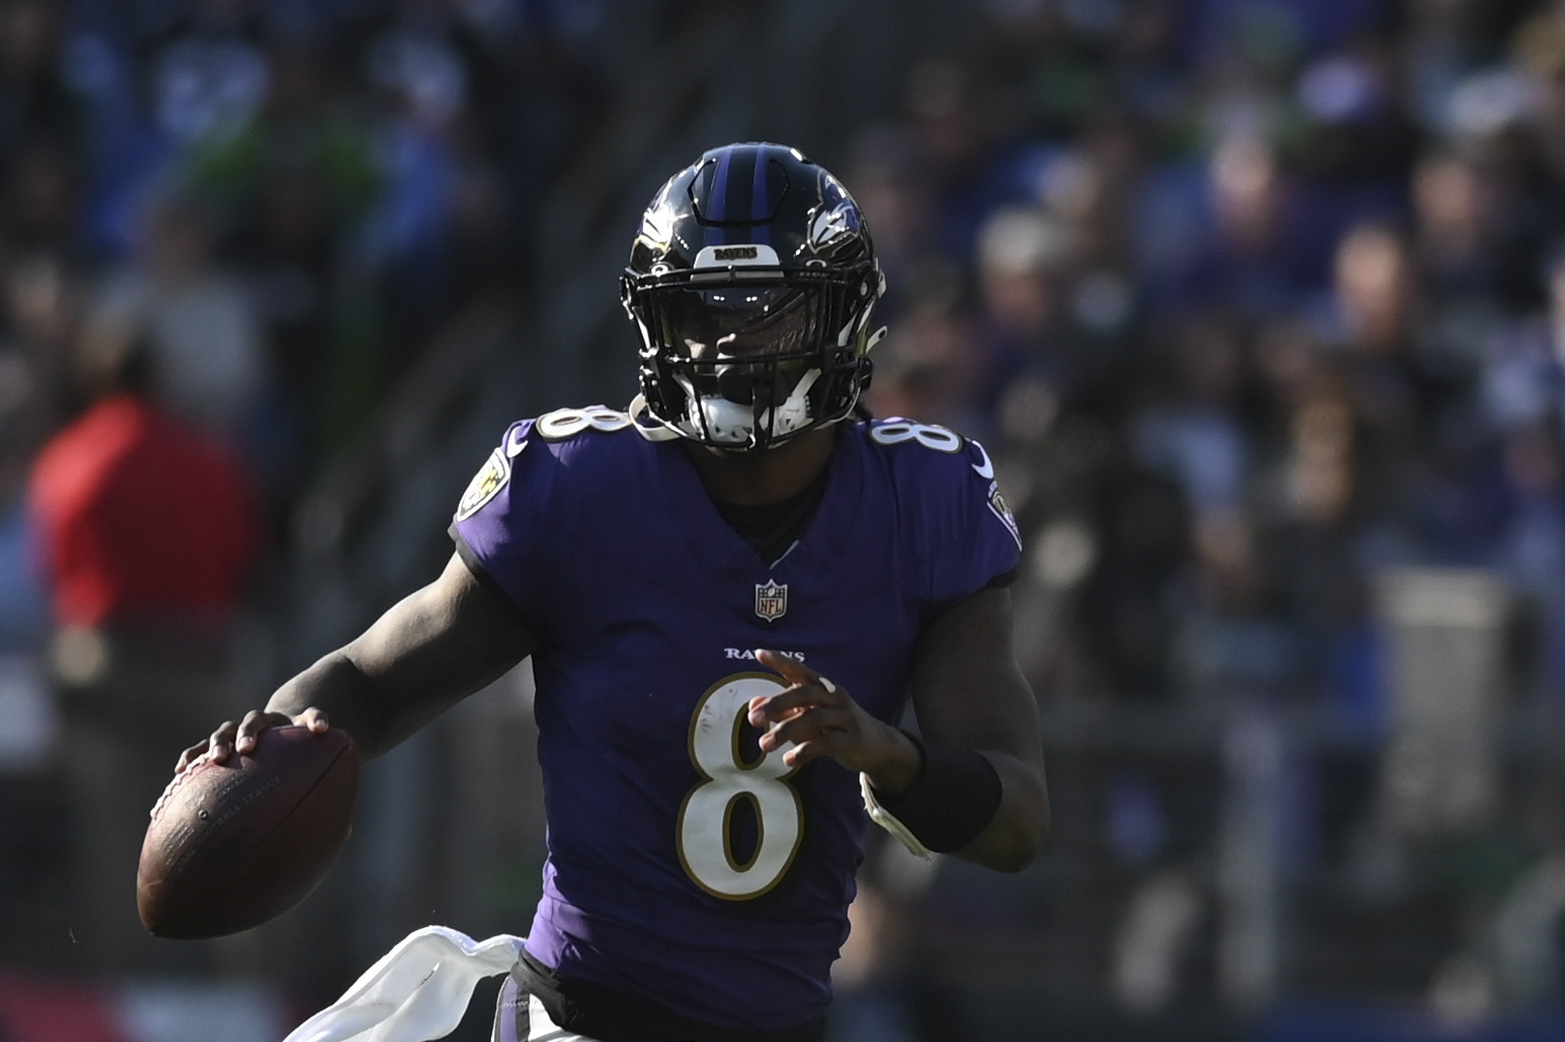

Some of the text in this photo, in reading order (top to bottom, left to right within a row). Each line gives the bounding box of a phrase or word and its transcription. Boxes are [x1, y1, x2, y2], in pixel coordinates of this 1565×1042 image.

[713, 246, 758, 261] RAVENS
[536, 408, 631, 441] 8
[869, 423, 962, 453] 8
[760, 599, 782, 614] NFL
[724, 648, 805, 662] RANS
[675, 671, 804, 900] 8
